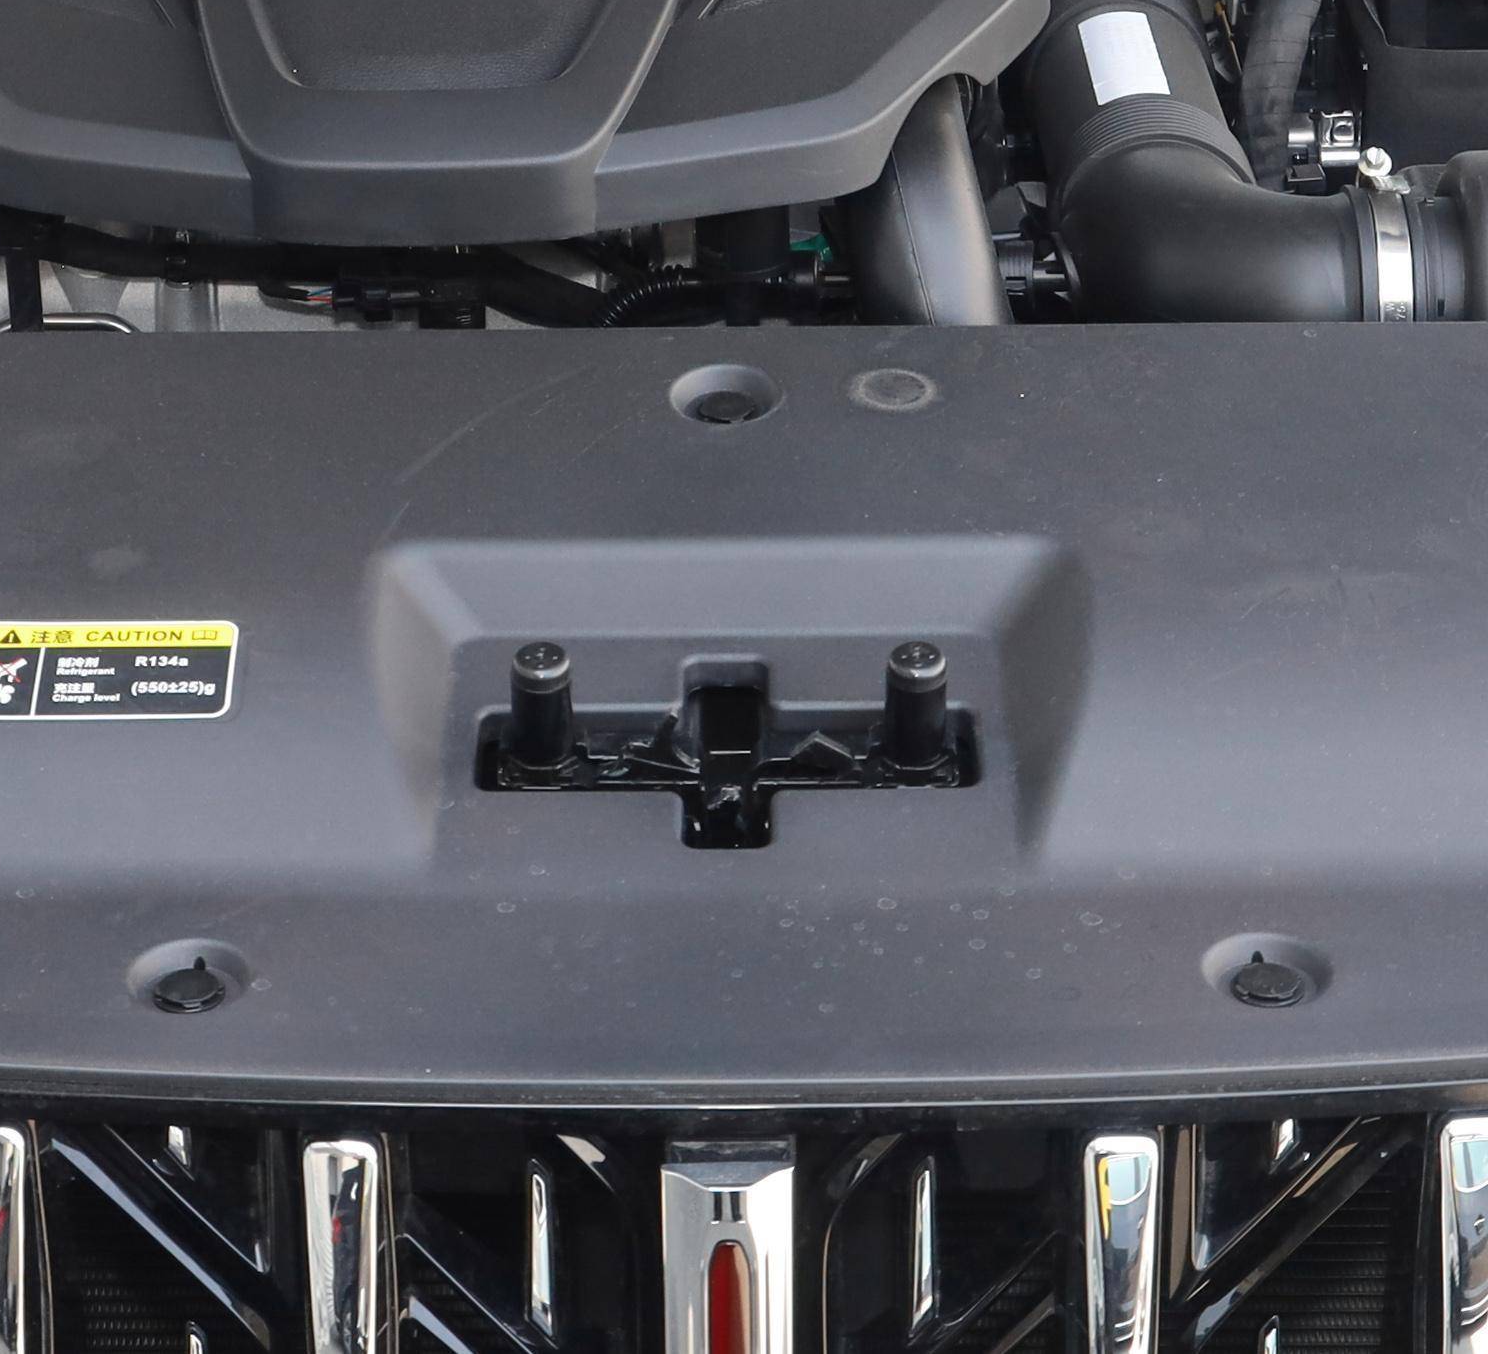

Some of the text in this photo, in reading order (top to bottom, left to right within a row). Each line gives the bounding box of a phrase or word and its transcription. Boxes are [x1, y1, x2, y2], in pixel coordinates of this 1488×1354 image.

[30, 630, 184, 644] 注意 CAUTION
[134, 655, 189, 667] R134a
[56, 667, 115, 676] Refrigerant
[130, 681, 216, 697] (550±25)g
[52, 693, 121, 704] Charge level
